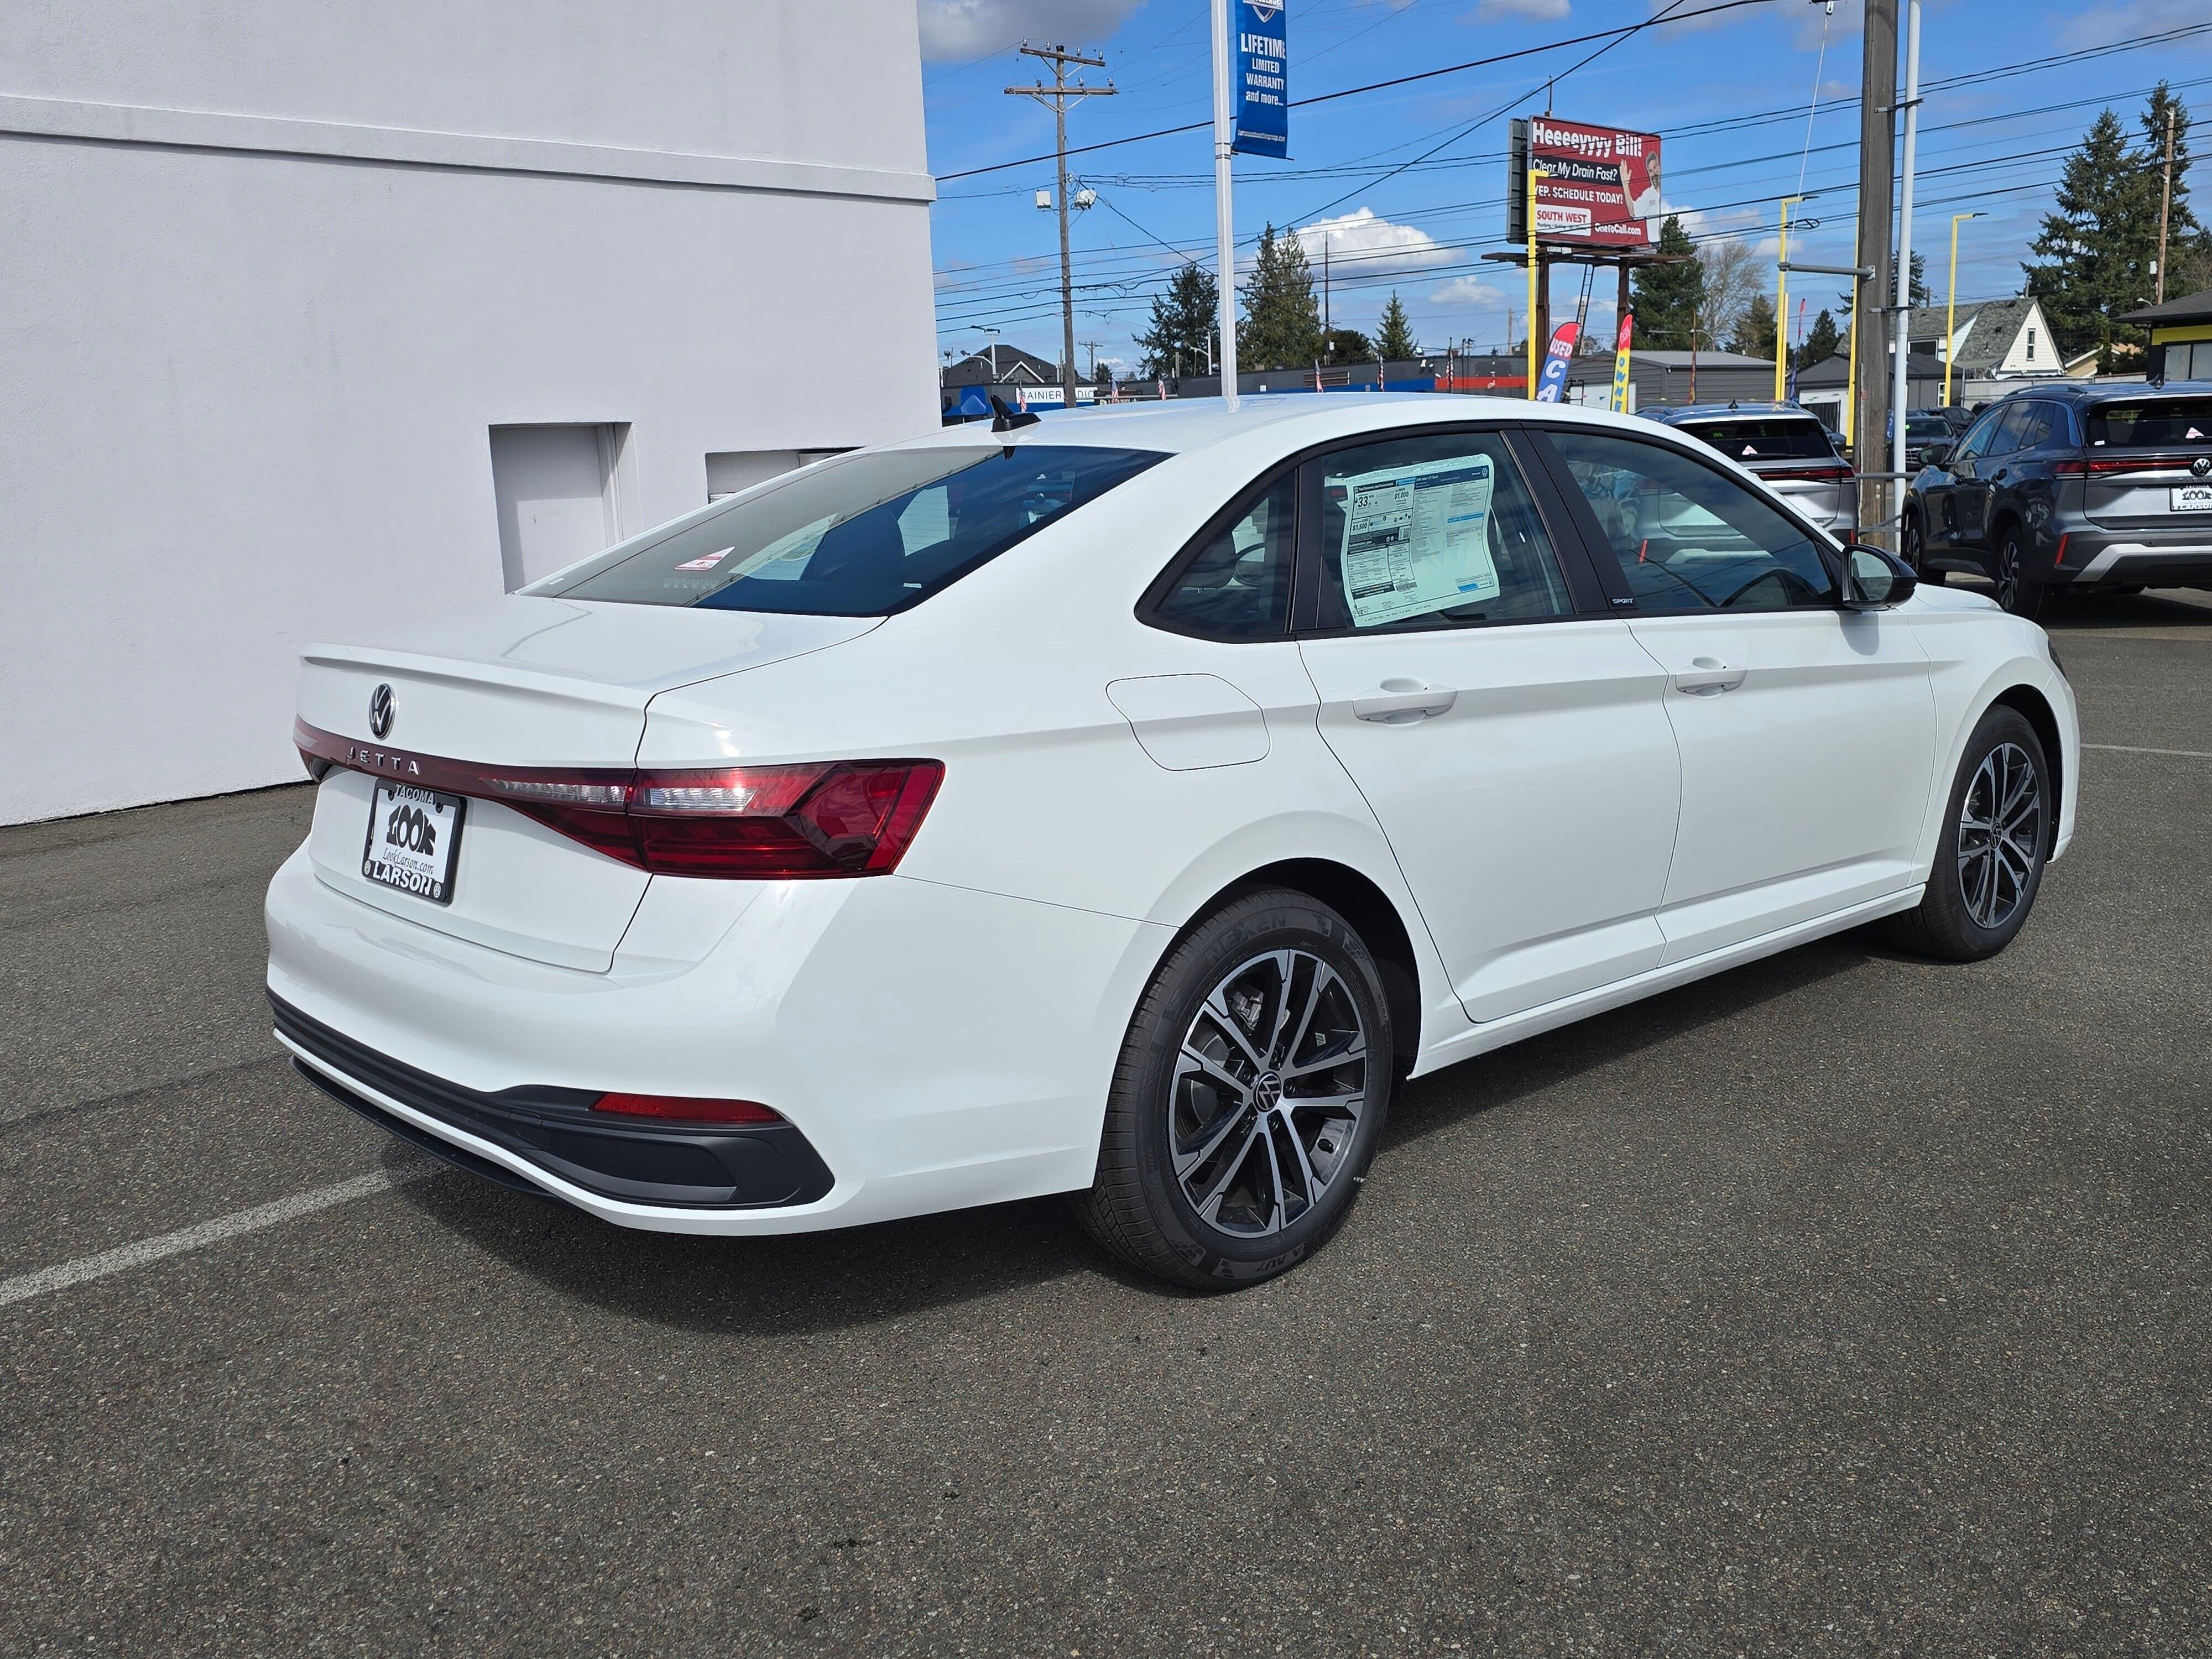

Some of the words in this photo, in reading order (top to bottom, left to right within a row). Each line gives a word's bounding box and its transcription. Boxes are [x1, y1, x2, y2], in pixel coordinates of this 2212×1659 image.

[1252, 58, 1280, 74] LIMITED
[1246, 72, 1284, 90] WARRANTY
[1245, 90, 1259, 102] and
[1532, 121, 1612, 158] Heeeeyyyy
[1615, 133, 1642, 158] Bill!
[1532, 158, 1556, 173] Clear
[1557, 161, 1571, 179] My
[1572, 164, 1594, 178] Drain
[1595, 166, 1618, 181] Fast?
[1552, 186, 1595, 202] SCHEDULE
[1595, 191, 1624, 205] TODAY!
[1536, 210, 1563, 221] SOUTH
[1566, 212, 1587, 223] WEST
[1550, 337, 1573, 357] USED
[1358, 495, 1369, 508] 33
[1352, 523, 1368, 531] $1,500
[346, 746, 420, 775] JETTA
[394, 784, 435, 804] TACOMA
[386, 805, 436, 857] LOOK
[382, 847, 435, 875] LookLarson.com
[372, 860, 432, 896] LARSON
